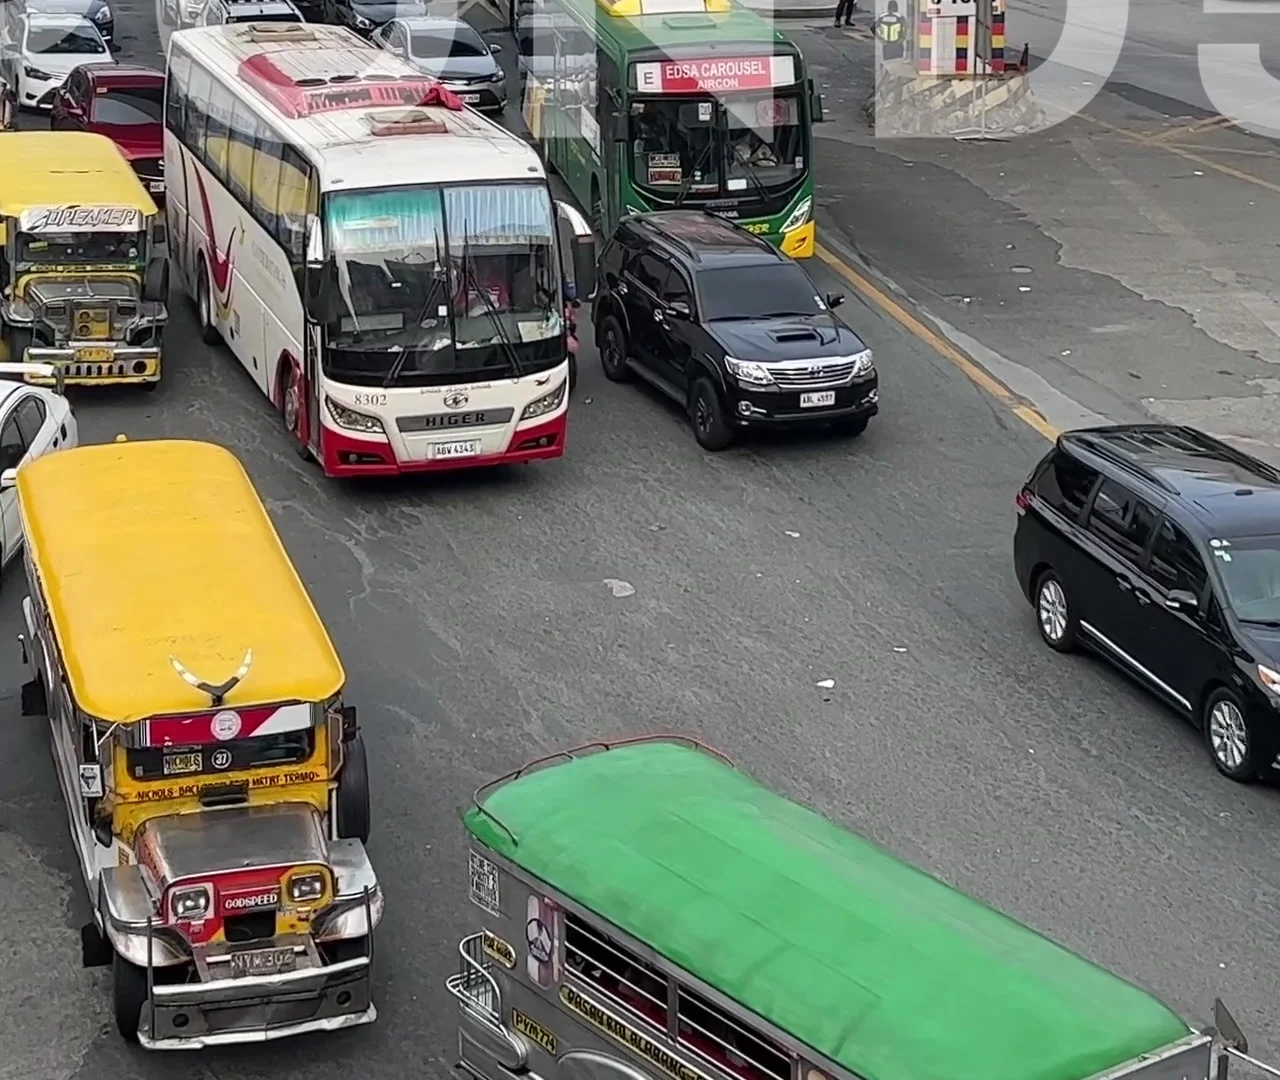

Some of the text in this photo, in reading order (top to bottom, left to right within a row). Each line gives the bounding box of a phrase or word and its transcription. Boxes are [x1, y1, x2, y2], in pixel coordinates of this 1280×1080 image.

[666, 60, 766, 78] EDSA CAROUSEL
[697, 79, 738, 89] AIRCON
[354, 394, 387, 406] 8302
[426, 413, 486, 427] HIGER
[215, 752, 228, 765] 37
[225, 893, 278, 909] GODSPEED
[567, 989, 604, 1027] PASAY
